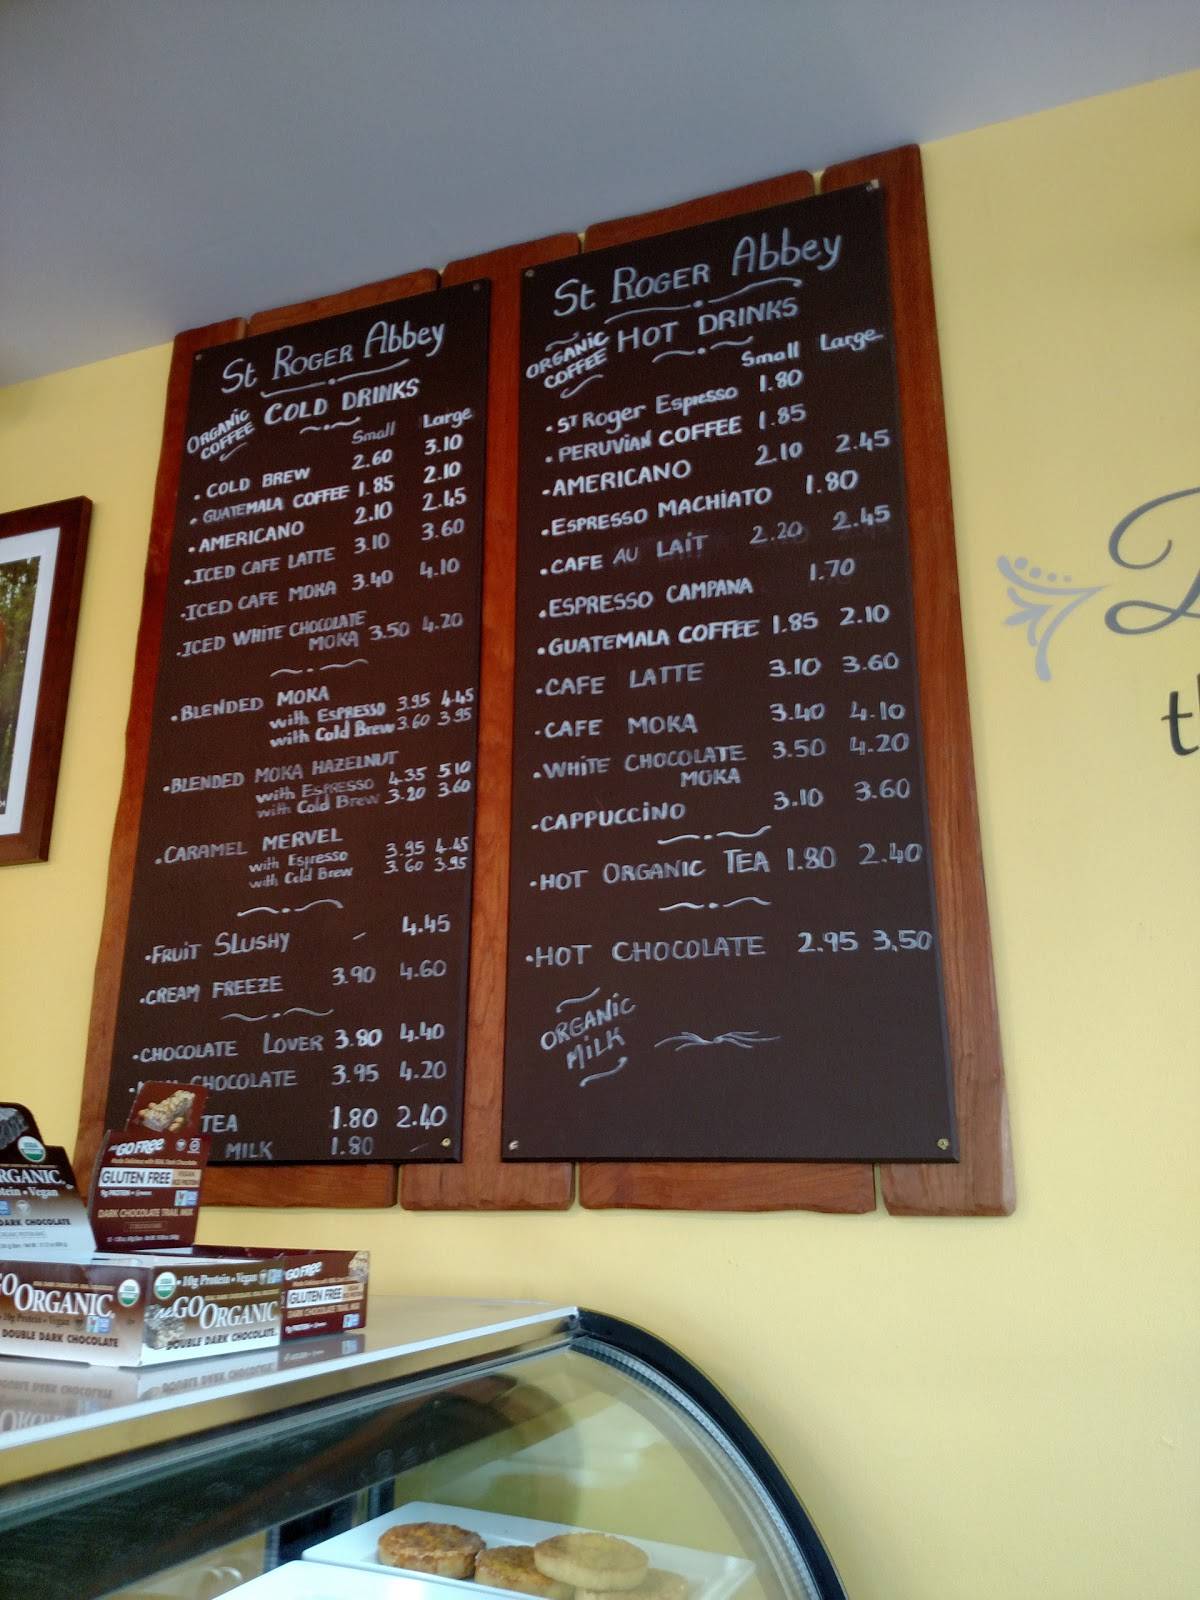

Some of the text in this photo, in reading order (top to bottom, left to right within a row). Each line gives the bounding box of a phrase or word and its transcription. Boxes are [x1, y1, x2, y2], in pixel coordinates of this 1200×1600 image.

[554, 279, 595, 316] St
[732, 228, 841, 276] Abbey
[618, 297, 798, 352] HOT DRINKS
[221, 358, 257, 393] St
[364, 321, 444, 358] Abbey
[741, 329, 883, 367] Small Large
[543, 349, 608, 389] COFFEE
[264, 378, 419, 425] COLD DRINKS
[583, 405, 646, 437] Roger
[760, 369, 803, 392] 1.80
[200, 424, 255, 460] COFFEE
[352, 408, 472, 444] Small Large
[659, 416, 741, 446] COFFEE
[759, 404, 806, 429] 1.85
[207, 434, 463, 498] COLD BREW 2.60 3.10
[553, 429, 890, 496] AMERICANO 2.10 2.45
[203, 461, 461, 523] GUATEMALA COFFEE 1.85 2.10
[806, 470, 858, 494] 1.80
[199, 487, 466, 552] AMERICANO 2.10 2.45
[192, 518, 464, 585] ICED CAFE LATTE 3.10 3.60
[551, 555, 602, 574] CAFE
[832, 505, 890, 530] 2.45
[185, 558, 460, 621] ICED CAFE MOKA 3.40 4.10
[549, 558, 855, 617] ESPRESSO CAMPANA 1.70
[181, 635, 226, 657] ICED
[289, 611, 366, 637] CHOCOLATE
[309, 613, 463, 650] MOKA 3.50 4.20
[548, 604, 890, 656] GUATEMALA COFFEE 1.85 2.10
[545, 652, 899, 696] CAFE LATTE 3.10 3.60
[181, 686, 329, 721] BLENDED MOKA
[269, 710, 309, 729] with
[545, 701, 905, 738] CAFE MOKA 3.40 4.10
[270, 729, 309, 747] with
[315, 720, 350, 741] Cold
[624, 745, 746, 772] CHOCOLATE
[773, 738, 825, 759] 3.50
[850, 733, 909, 755] 4.20
[171, 772, 244, 794] BLENDED
[255, 764, 303, 783] MOKA
[256, 787, 295, 803] with
[681, 768, 741, 787] MOKA
[774, 788, 823, 810] 3.10
[855, 778, 910, 801] 3.60
[164, 842, 248, 863] CARAMEL
[262, 828, 343, 851] MERVEL
[540, 870, 588, 890] HOT
[723, 849, 770, 873] TEA
[787, 846, 836, 870] 1.80
[859, 843, 922, 864] 2.40
[402, 914, 450, 935] 4.45
[536, 945, 592, 967] HOT
[612, 936, 765, 962] CHOCOLATE
[798, 932, 858, 952] 2.95
[145, 960, 446, 1005] CREAM FREEZE 3.90 4.60
[140, 1022, 444, 1063] CHOCOLATE LOVER 3.80 4.40
[332, 1064, 379, 1085] 3.95
[400, 1061, 446, 1081] 4.20
[201, 1104, 447, 1132] TEA 1.80 2.40
[226, 1141, 272, 1160] MILK
[102, 1171, 145, 1184] GLUTEN
[147, 1171, 171, 1184] FREE
[14, 1283, 115, 1318] ORGANIC
[201, 1301, 278, 1329] ORGANIC
[2, 1329, 119, 1347] DOUBLE DARK CHOCOLATE
